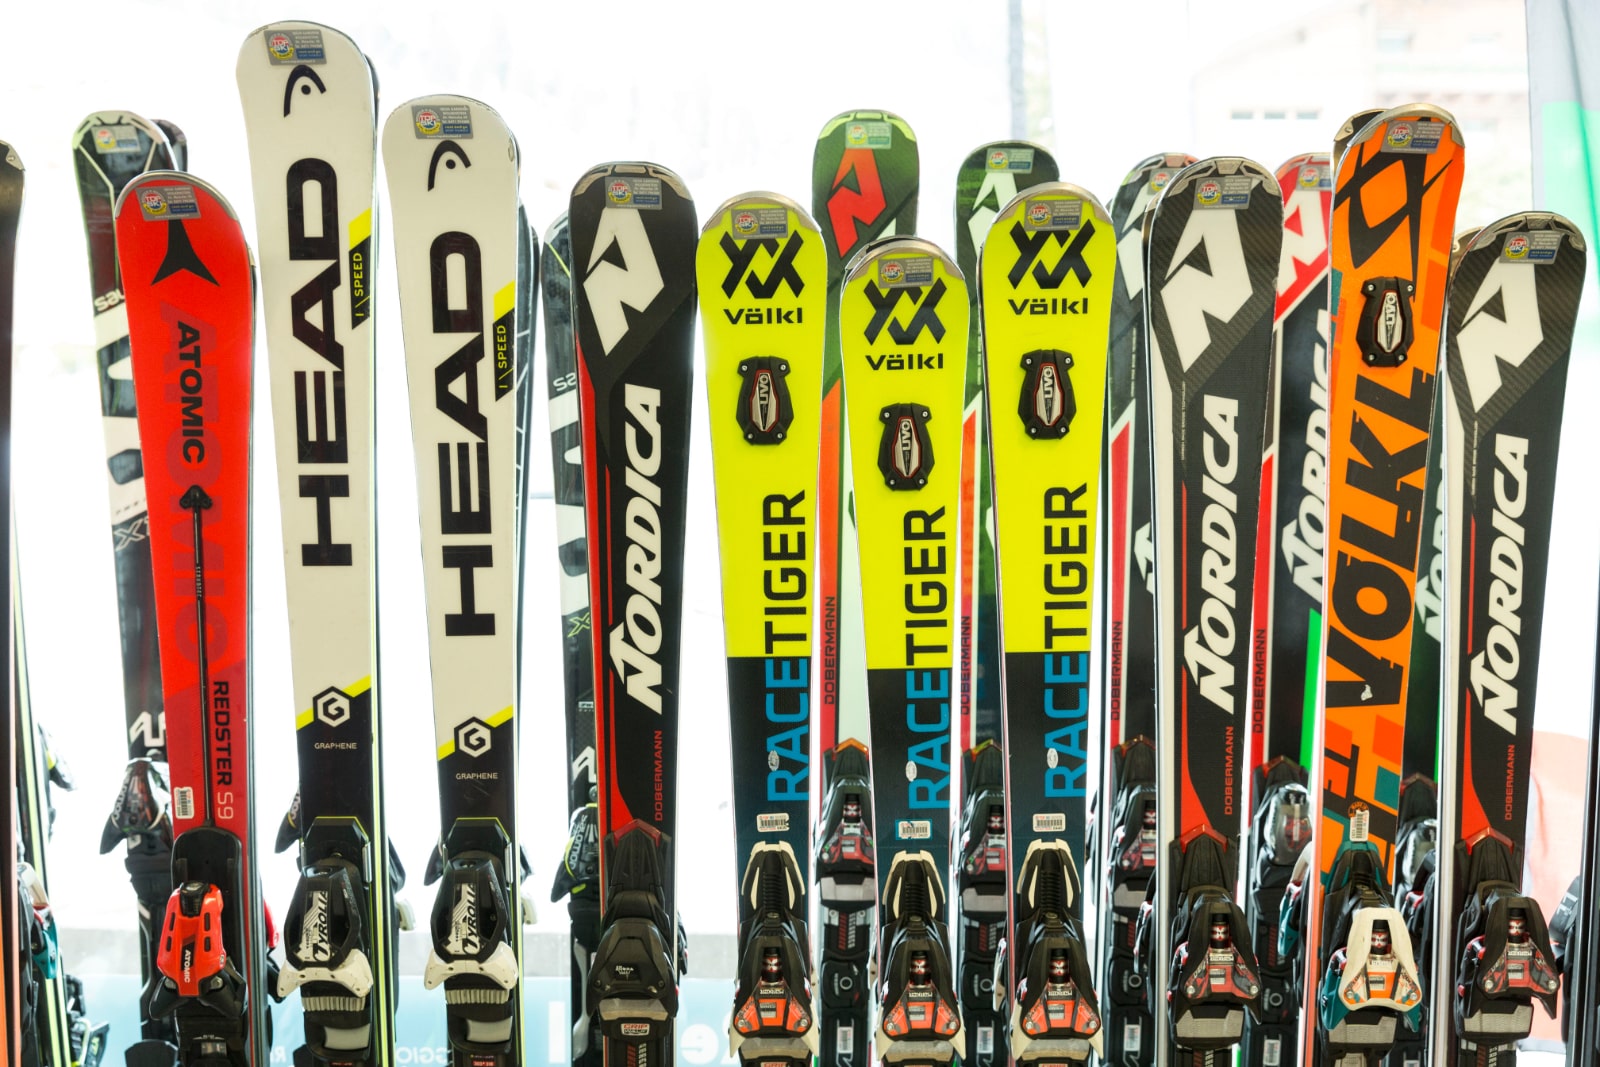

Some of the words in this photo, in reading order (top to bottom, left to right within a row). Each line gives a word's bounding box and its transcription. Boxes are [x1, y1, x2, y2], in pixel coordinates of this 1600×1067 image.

[353, 252, 364, 298] SPEED
[723, 307, 803, 325] Völkl
[1008, 297, 1089, 315] Völkl
[177, 320, 206, 464] ATOMIC
[286, 157, 353, 567] HEAD
[497, 324, 508, 370] SPEED
[760, 375, 769, 405] UVO
[865, 353, 944, 371] Völkl
[1043, 367, 1053, 398] UVO
[429, 230, 496, 636] HEAD
[901, 421, 911, 451] UVO
[609, 383, 663, 715] NORDICA
[1184, 394, 1239, 715] NORDICA
[1470, 433, 1529, 736] NORDICA
[824, 596, 836, 705] DOBERMANN
[960, 615, 971, 716] DOBERMANN
[1111, 620, 1122, 721] DOBERMANN
[1252, 628, 1264, 734] DOBERMANN
[213, 680, 233, 787] REDSTER
[314, 742, 358, 750] GRAPHENE
[455, 772, 499, 780] GRAPHENE
[654, 729, 663, 822] DOBERMANN
[1224, 726, 1234, 816] DOBERMANN
[217, 791, 234, 820] S9
[1504, 744, 1515, 821] DOBERMANN
